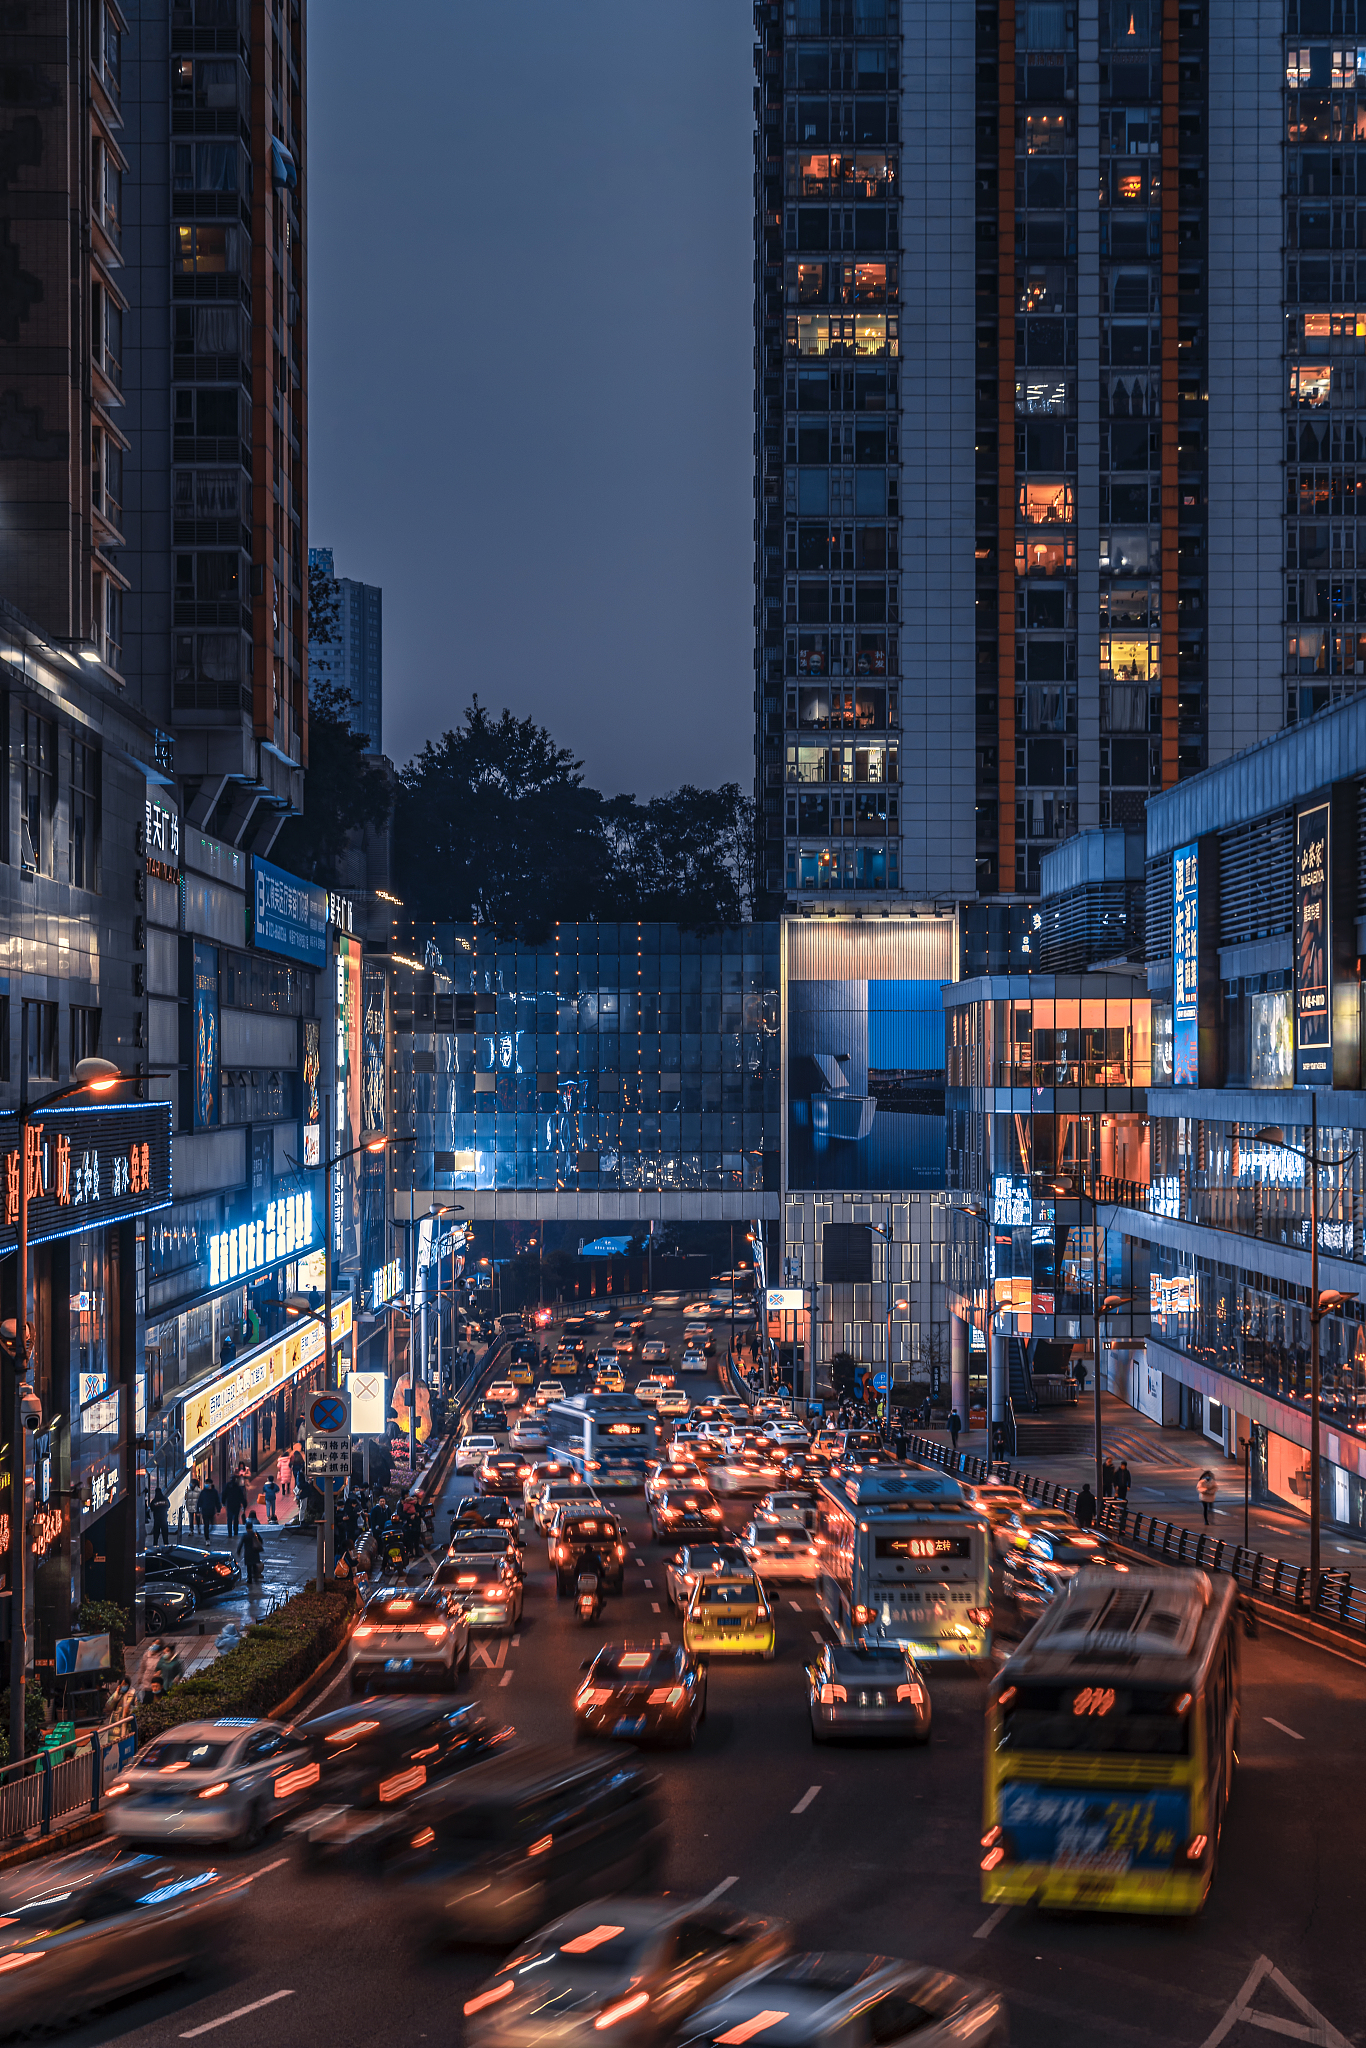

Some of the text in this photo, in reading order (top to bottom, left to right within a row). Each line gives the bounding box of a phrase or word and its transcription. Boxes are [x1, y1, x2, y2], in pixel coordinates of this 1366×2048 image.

[308, 1440, 348, 1449] 网格内
[308, 1451, 348, 1461] 禁止停车
